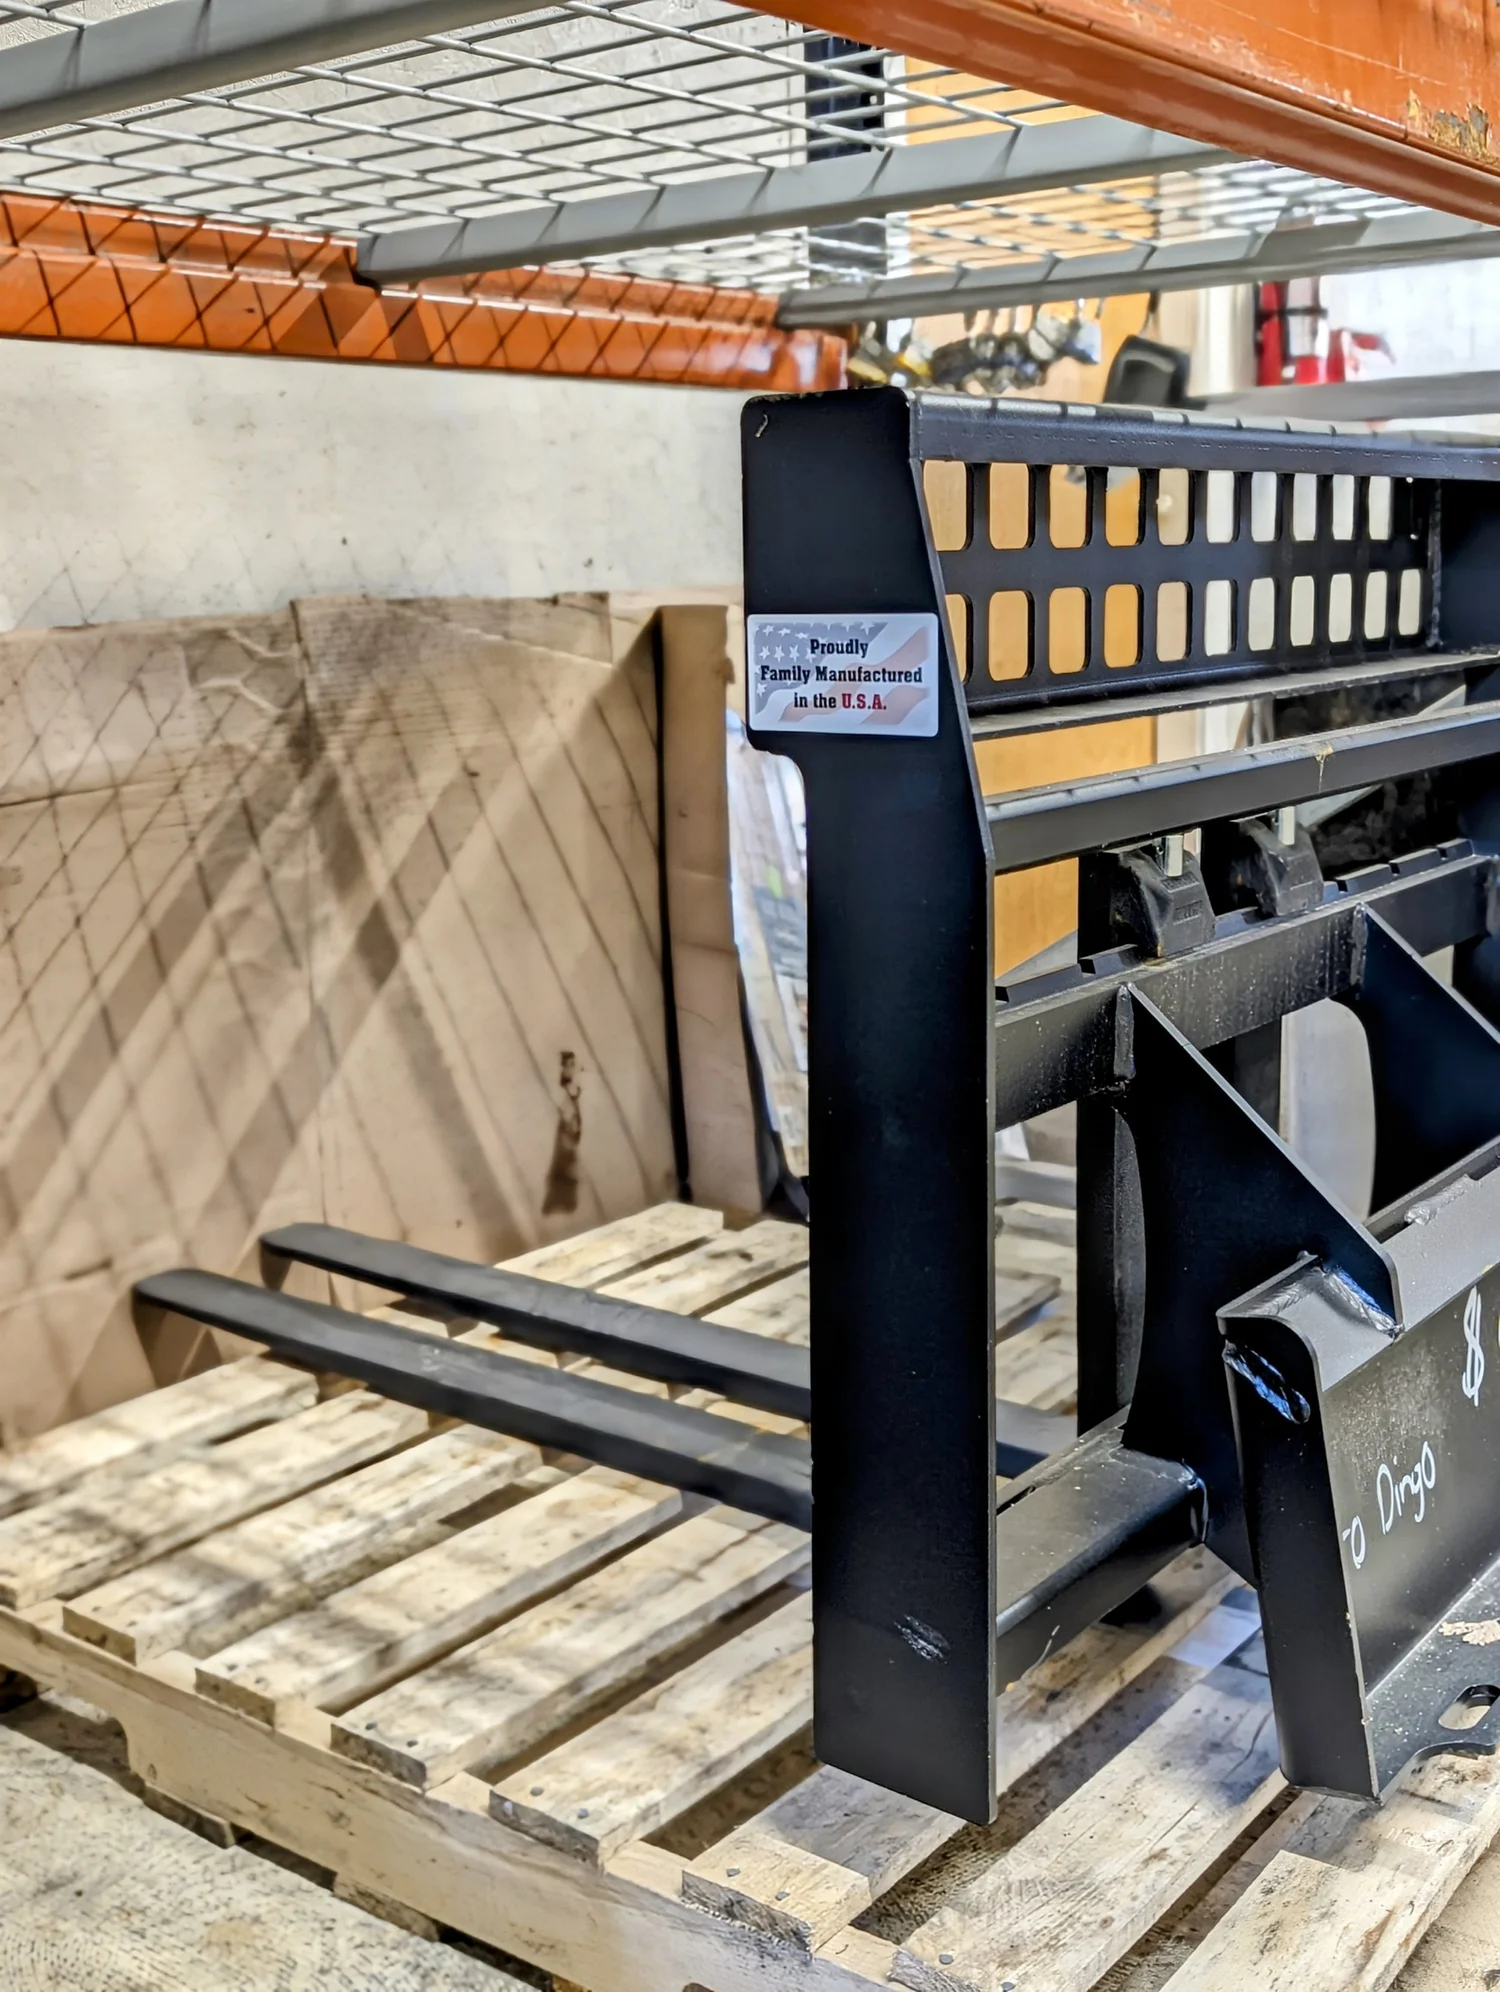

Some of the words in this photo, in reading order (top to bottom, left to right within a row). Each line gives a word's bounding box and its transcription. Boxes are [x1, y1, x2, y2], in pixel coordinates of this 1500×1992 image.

[810, 639, 868, 658] Proudly
[760, 665, 811, 684] Family
[815, 666, 923, 683] Manufactured
[793, 692, 808, 708] in
[813, 694, 837, 708] the
[841, 693, 887, 710] U.S.A.
